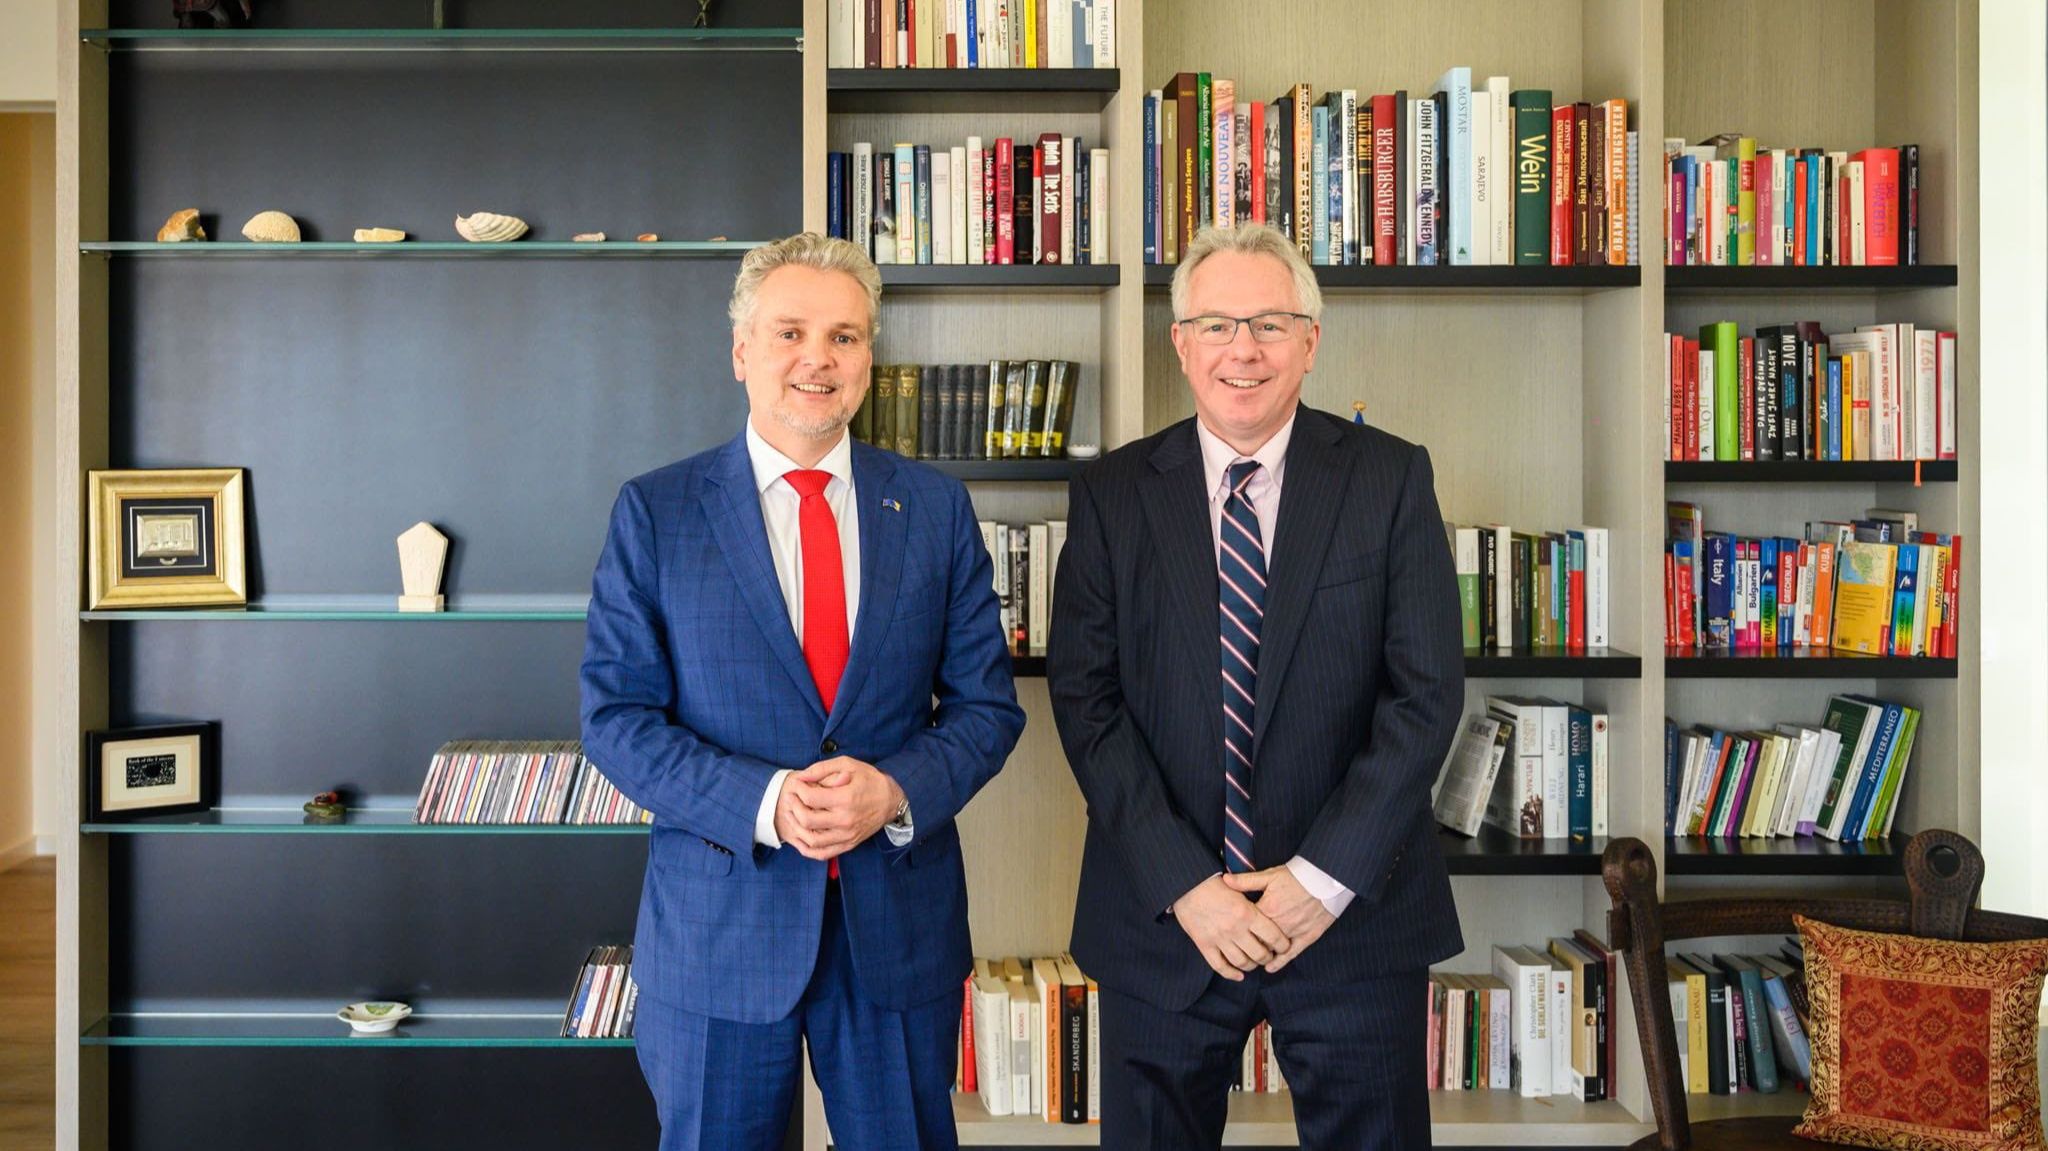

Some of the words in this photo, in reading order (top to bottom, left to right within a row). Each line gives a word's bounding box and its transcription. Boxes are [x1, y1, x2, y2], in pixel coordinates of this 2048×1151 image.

[1100, 6, 1109, 24] THE
[1100, 25, 1109, 58] FUTURE
[1202, 84, 1210, 110] Albania
[1346, 98, 1355, 117] CARS
[1456, 85, 1468, 135] MOSTAR
[1202, 110, 1210, 125] from
[1235, 114, 1248, 143] THE
[1420, 101, 1432, 130] JOHN
[1202, 126, 1210, 137] the
[1202, 137, 1210, 149] Air
[1346, 125, 1355, 156] SIZZLING
[1612, 104, 1624, 181] SPRINGSTEEN
[1042, 140, 1060, 166] Judah
[1217, 112, 1230, 186] NOUVEAU
[1420, 133, 1432, 195] FITZGERALD
[1520, 134, 1547, 195] Wein
[985, 156, 995, 177] How
[1044, 174, 1060, 189] The
[1376, 127, 1394, 217] HABSBURGER
[1476, 156, 1487, 203] SARAJEVO
[985, 178, 995, 187] to
[985, 189, 995, 202] Do
[1577, 188, 1587, 205] Бан
[1044, 191, 1060, 215] Serbs
[984, 204, 995, 239] Nothing
[1381, 218, 1394, 236] DIE
[1420, 195, 1432, 247] KENNEDY
[1612, 213, 1624, 251] OBAMA
[1767, 348, 1777, 380] NACHT
[1782, 334, 1797, 367] MOVE
[1920, 337, 1935, 375] 1977
[1754, 359, 1766, 392] OVČINA
[1687, 391, 1696, 410] Bridge
[1756, 396, 1766, 428] DAMIR
[1767, 381, 1778, 412] JAHRE
[1700, 396, 1713, 437] FLOW
[1767, 414, 1777, 439] ZWEI
[1688, 430, 1696, 449] Drina
[1487, 536, 1496, 549] IVO
[1711, 558, 1725, 586] Italy
[1819, 547, 1832, 574] KUBA
[1748, 563, 1759, 609] Bulgarien
[1783, 554, 1793, 604] GRIECHENLAND
[1934, 551, 1947, 609] MAZEDONIEN
[1570, 720, 1581, 757] HOMO
[1866, 709, 1899, 784] MEDITERRANEO
[1574, 764, 1586, 799] Harari
[1733, 1003, 1743, 1019] John
[1780, 1004, 1802, 1036] 1913
[1072, 1015, 1080, 1072] SKANDERBEG
[1733, 1019, 1744, 1038] Irving
